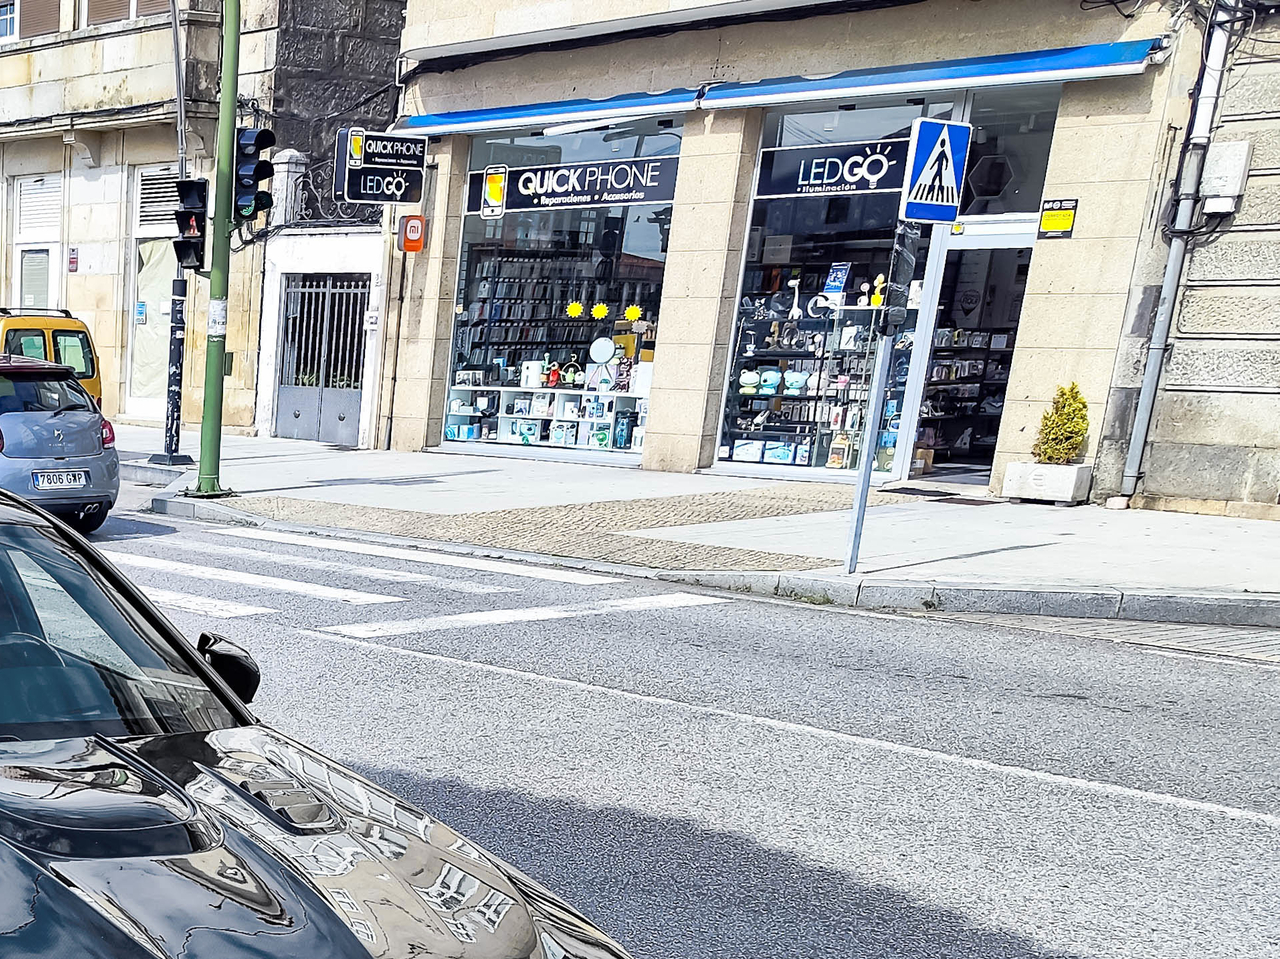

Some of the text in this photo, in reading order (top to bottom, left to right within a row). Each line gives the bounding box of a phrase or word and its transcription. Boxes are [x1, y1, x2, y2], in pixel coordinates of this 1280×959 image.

[518, 162, 661, 196] QUICK PHONE
[798, 151, 889, 189] LEDGO
[540, 189, 645, 206] Reparaciones Accesorios
[40, 474, 64, 485] 7806
